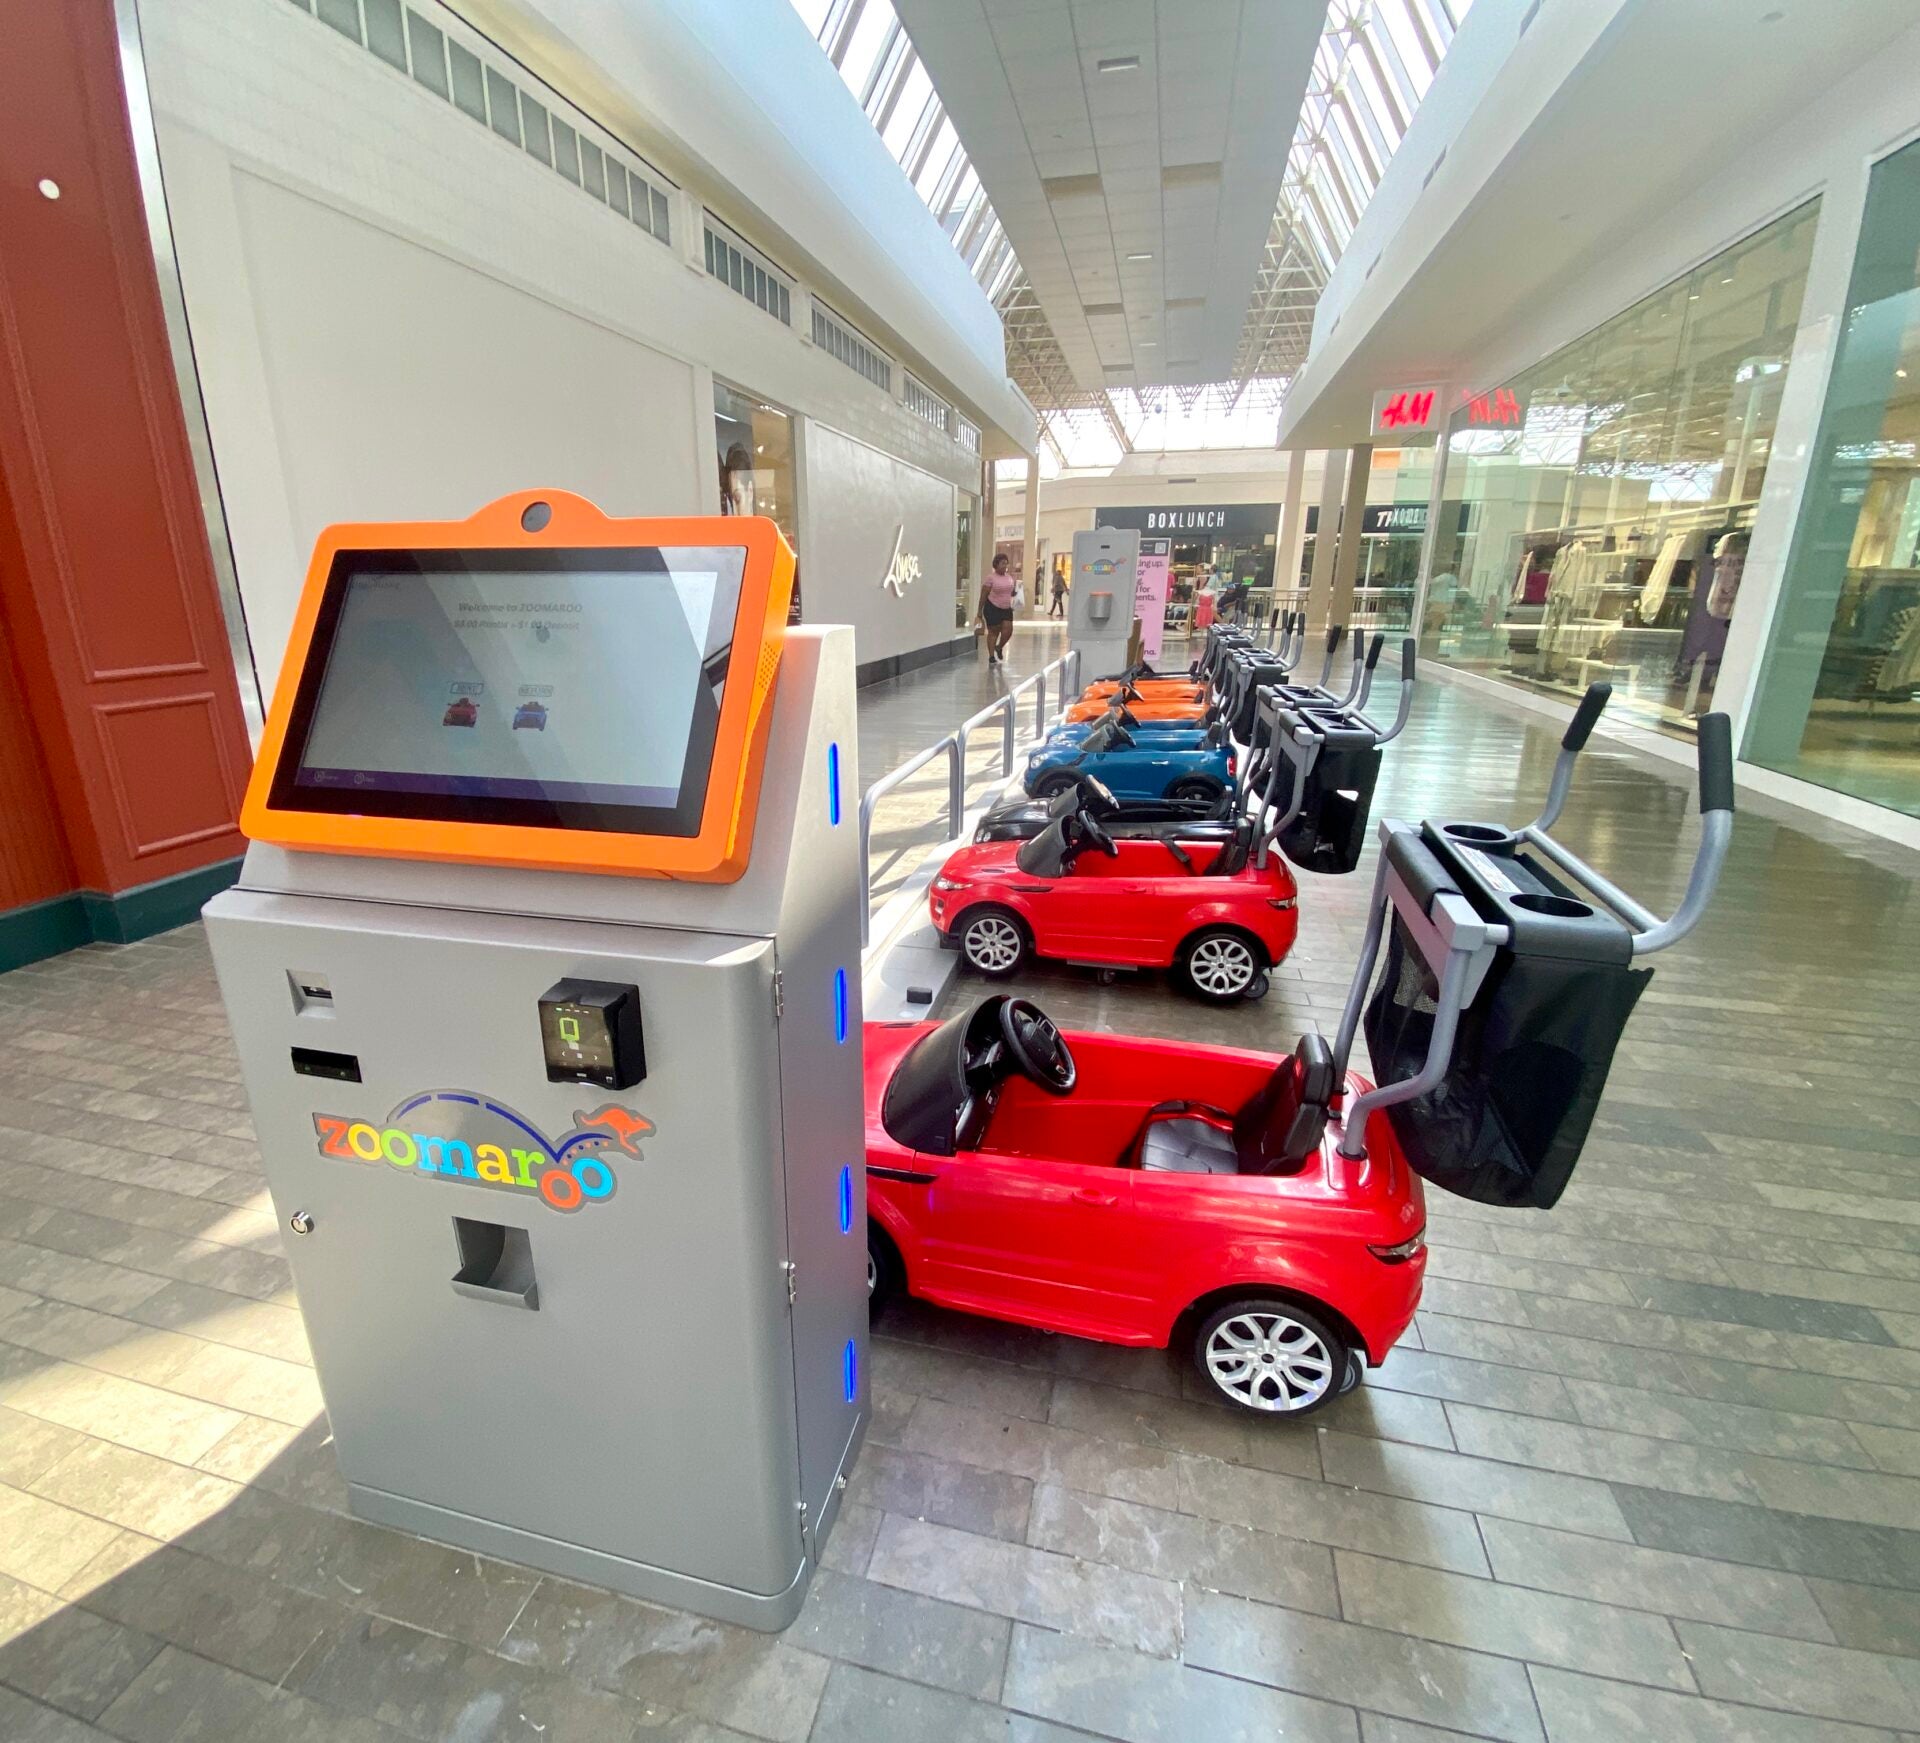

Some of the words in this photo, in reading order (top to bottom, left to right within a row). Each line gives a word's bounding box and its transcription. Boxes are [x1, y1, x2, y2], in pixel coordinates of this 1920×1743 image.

[1379, 389, 1437, 429] H&M
[1147, 511, 1225, 529] BOXLUNCH
[883, 524, 922, 598] Lovisa
[1138, 559, 1151, 568] ing
[458, 602, 505, 612] Welcome
[506, 602, 518, 612] to
[520, 602, 583, 613] ZOOMAROO
[317, 1117, 614, 1209] zoomaroo
